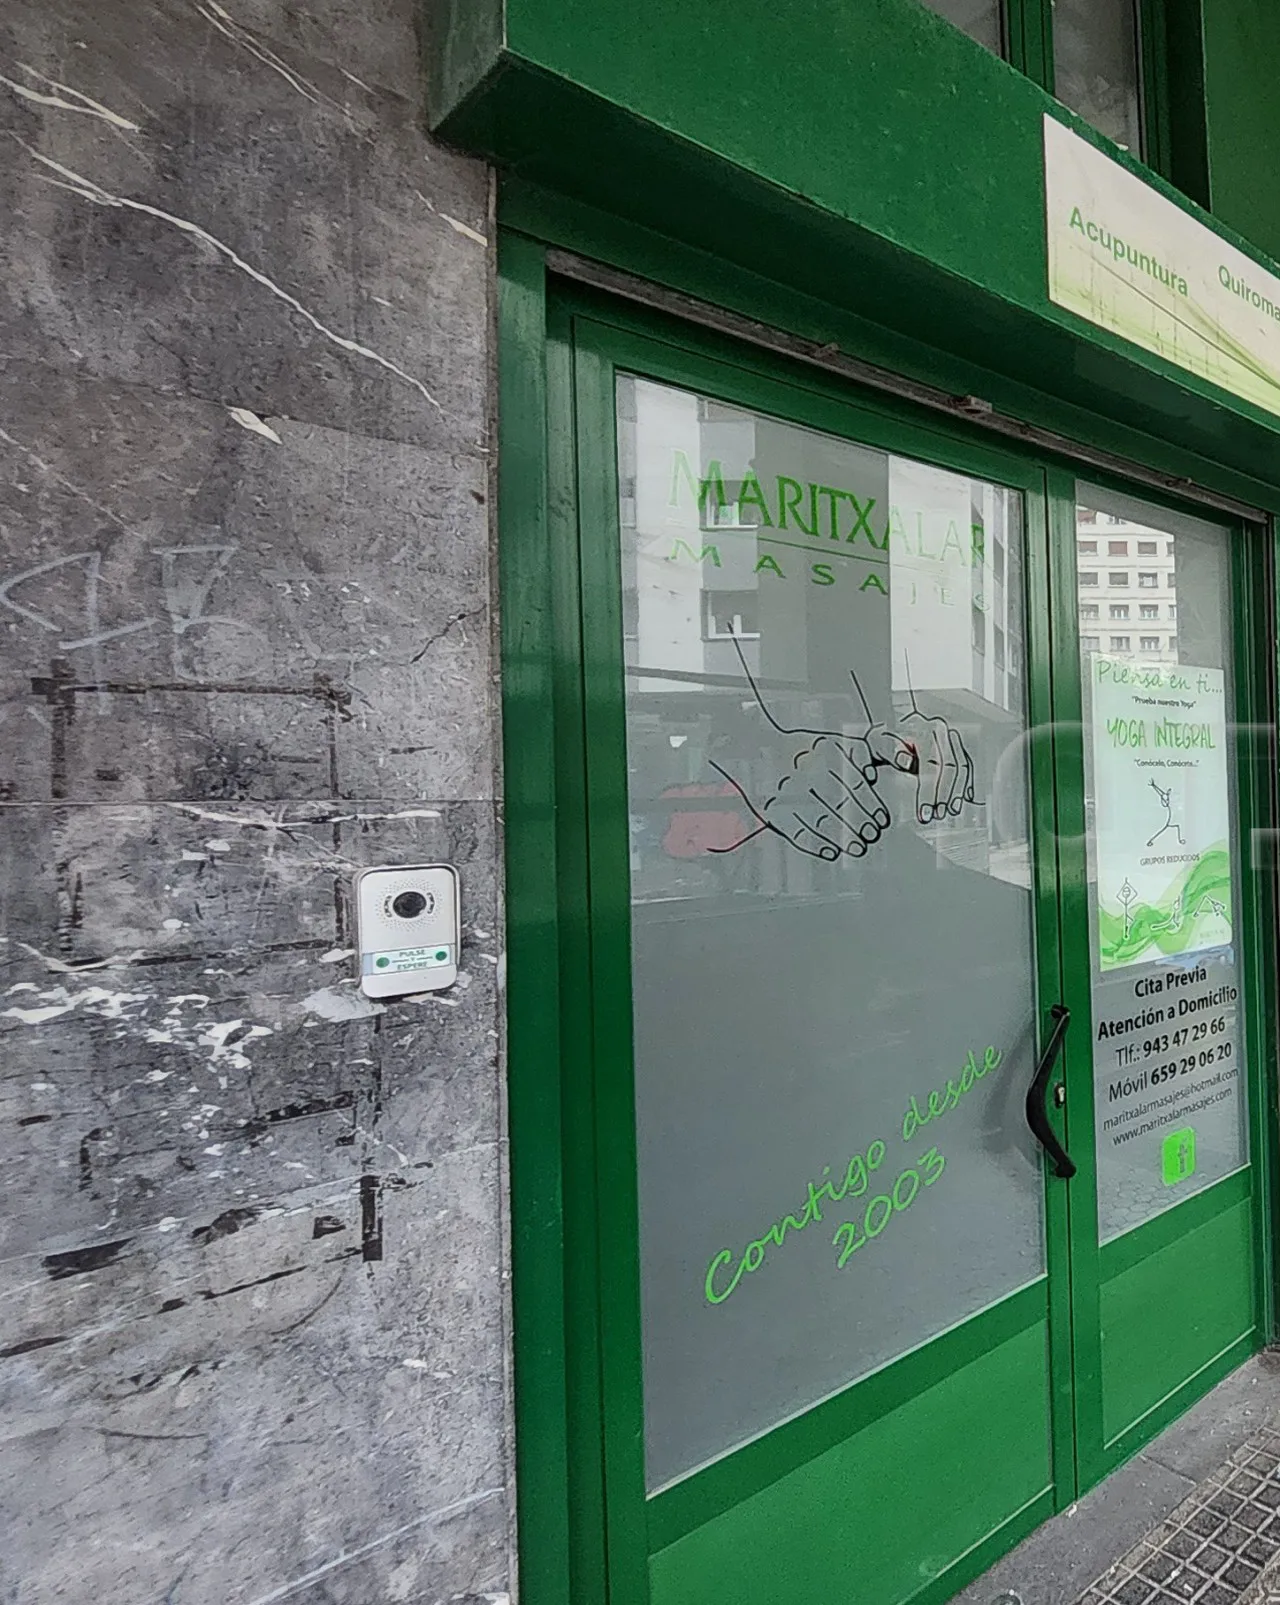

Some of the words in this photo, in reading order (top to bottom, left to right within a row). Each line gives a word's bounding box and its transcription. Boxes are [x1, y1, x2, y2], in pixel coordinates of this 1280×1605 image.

[1069, 205, 1189, 297] Acupuntura
[669, 538, 991, 612] MASAJES
[1095, 659, 1164, 688] Piensa
[1169, 674, 1191, 690] en
[1106, 717, 1147, 748] YOGA
[1154, 716, 1216, 749] INTEGRAL
[1140, 856, 1166, 866] GRUPOS
[1166, 853, 1201, 864] REDUCIDOS
[399, 948, 426, 957] PULSE
[1134, 978, 1163, 998] Cita
[1166, 965, 1208, 990] Previa
[1098, 1007, 1164, 1041] Atención
[1167, 1006, 1176, 1020] a
[1178, 986, 1238, 1016] Domicilio
[1143, 1034, 1169, 1059] 943
[1172, 1028, 1189, 1049] 47
[1193, 1022, 1208, 1044] 29
[1210, 1016, 1226, 1035] 66
[1103, 1067, 1239, 1132] maritxalarmasajes@hotmail.com
[1108, 1072, 1149, 1103] Móvil
[1150, 1064, 1177, 1086] 659
[1180, 1056, 1197, 1075] 29
[1199, 1049, 1215, 1069] 06
[1217, 1042, 1233, 1061] 20
[1112, 1086, 1233, 1146] www.maritxalarmasajes.com
[705, 1140, 886, 1304] Contigo
[903, 1046, 1002, 1141] desde
[832, 1147, 945, 1270] 2003
